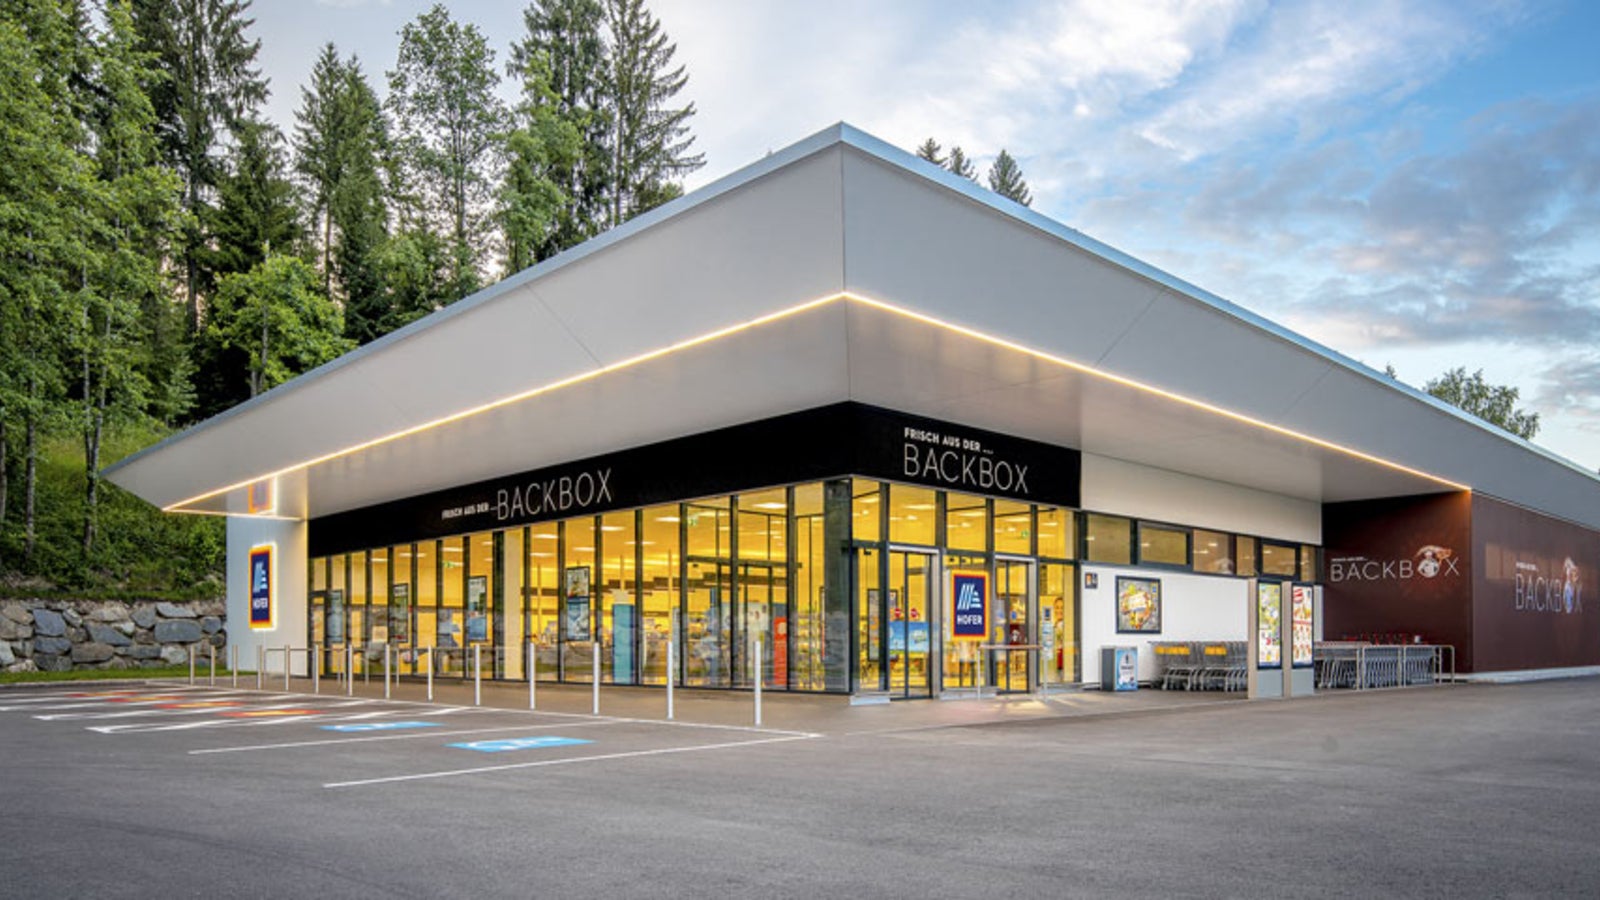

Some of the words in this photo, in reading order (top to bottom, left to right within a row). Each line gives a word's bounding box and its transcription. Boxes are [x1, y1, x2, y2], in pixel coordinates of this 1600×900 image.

[904, 427, 939, 443] FRISCH
[942, 435, 961, 447] AUS
[963, 438, 981, 451] DER
[904, 445, 1028, 494] BACKBOX
[497, 467, 612, 521] BACKBOX
[957, 614, 984, 626] HOFER
